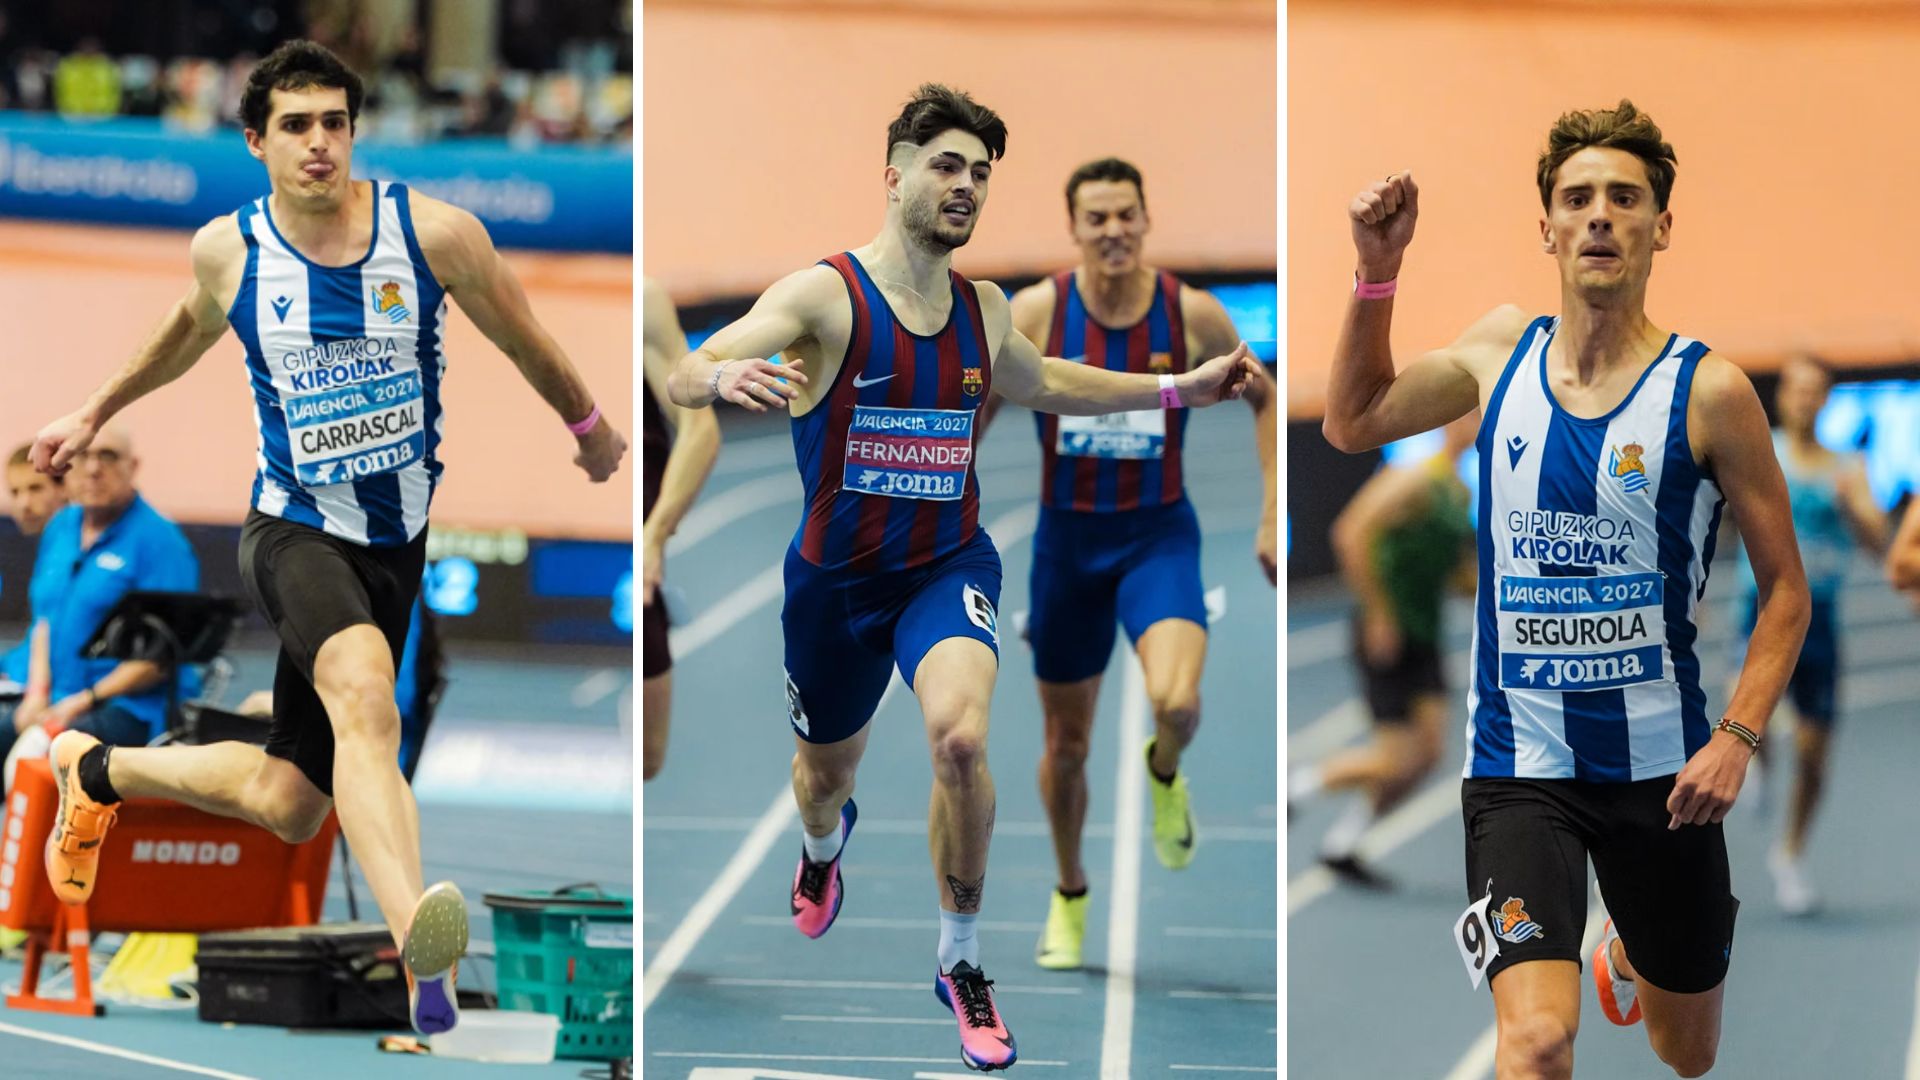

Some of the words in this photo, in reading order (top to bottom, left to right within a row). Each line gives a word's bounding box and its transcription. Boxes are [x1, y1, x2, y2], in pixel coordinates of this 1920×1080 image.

[283, 337, 398, 371] GIPUZKOA
[291, 356, 396, 391] KIROLAK
[291, 393, 369, 420] VALENCIA
[374, 378, 415, 403] 2027
[300, 405, 418, 455] CARRASCAL
[855, 414, 927, 431] VALENCIA
[932, 417, 969, 431] 2027
[846, 440, 971, 465] FERNANDEZ
[1508, 510, 1636, 541] GIPUZKOA
[1512, 537, 1631, 565] KIROLAK
[1506, 585, 1593, 604] VALENCIA
[1601, 580, 1655, 603] 2027
[1515, 612, 1648, 646] SEGUROLA
[131, 840, 241, 865] MONDO
[1462, 911, 1487, 970] 9
